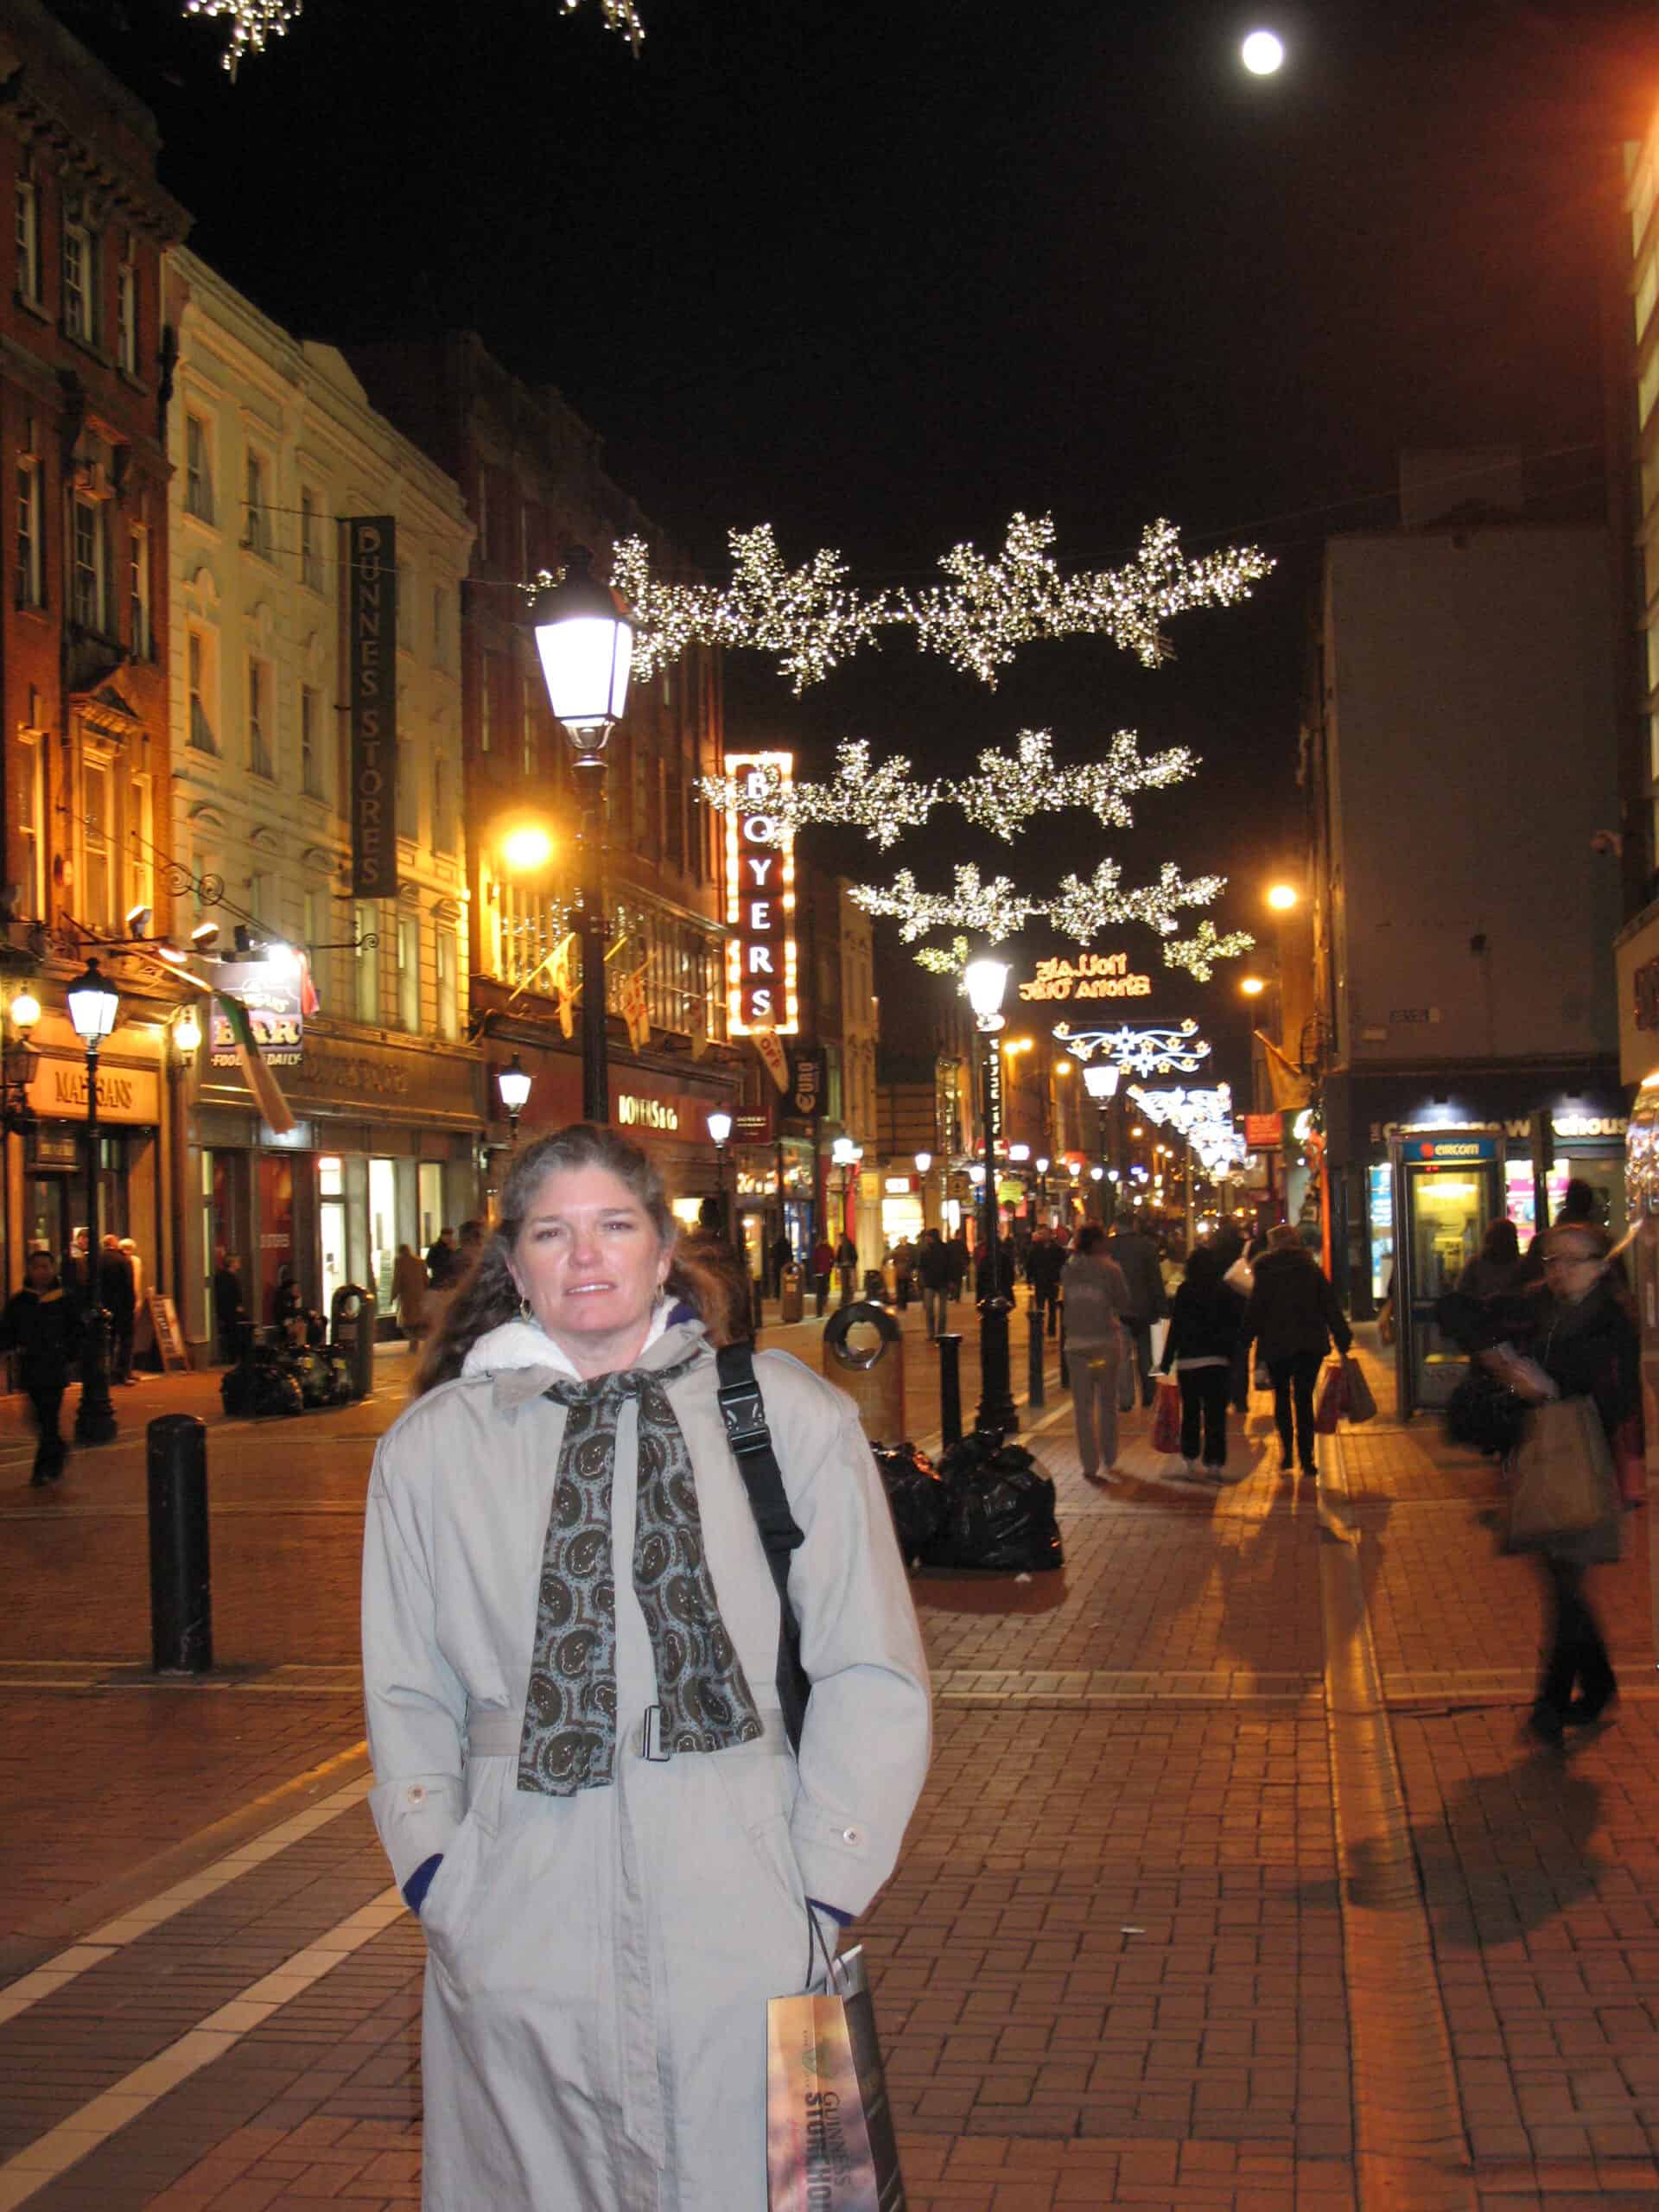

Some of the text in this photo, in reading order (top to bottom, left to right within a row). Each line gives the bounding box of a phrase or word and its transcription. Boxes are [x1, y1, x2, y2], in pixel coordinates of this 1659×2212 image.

[357, 525, 384, 885] DUNNES STORES
[742, 772, 776, 1018] BOYERS
[213, 1017, 301, 1046] BAR
[823, 2091, 851, 2187] GUINNESS
